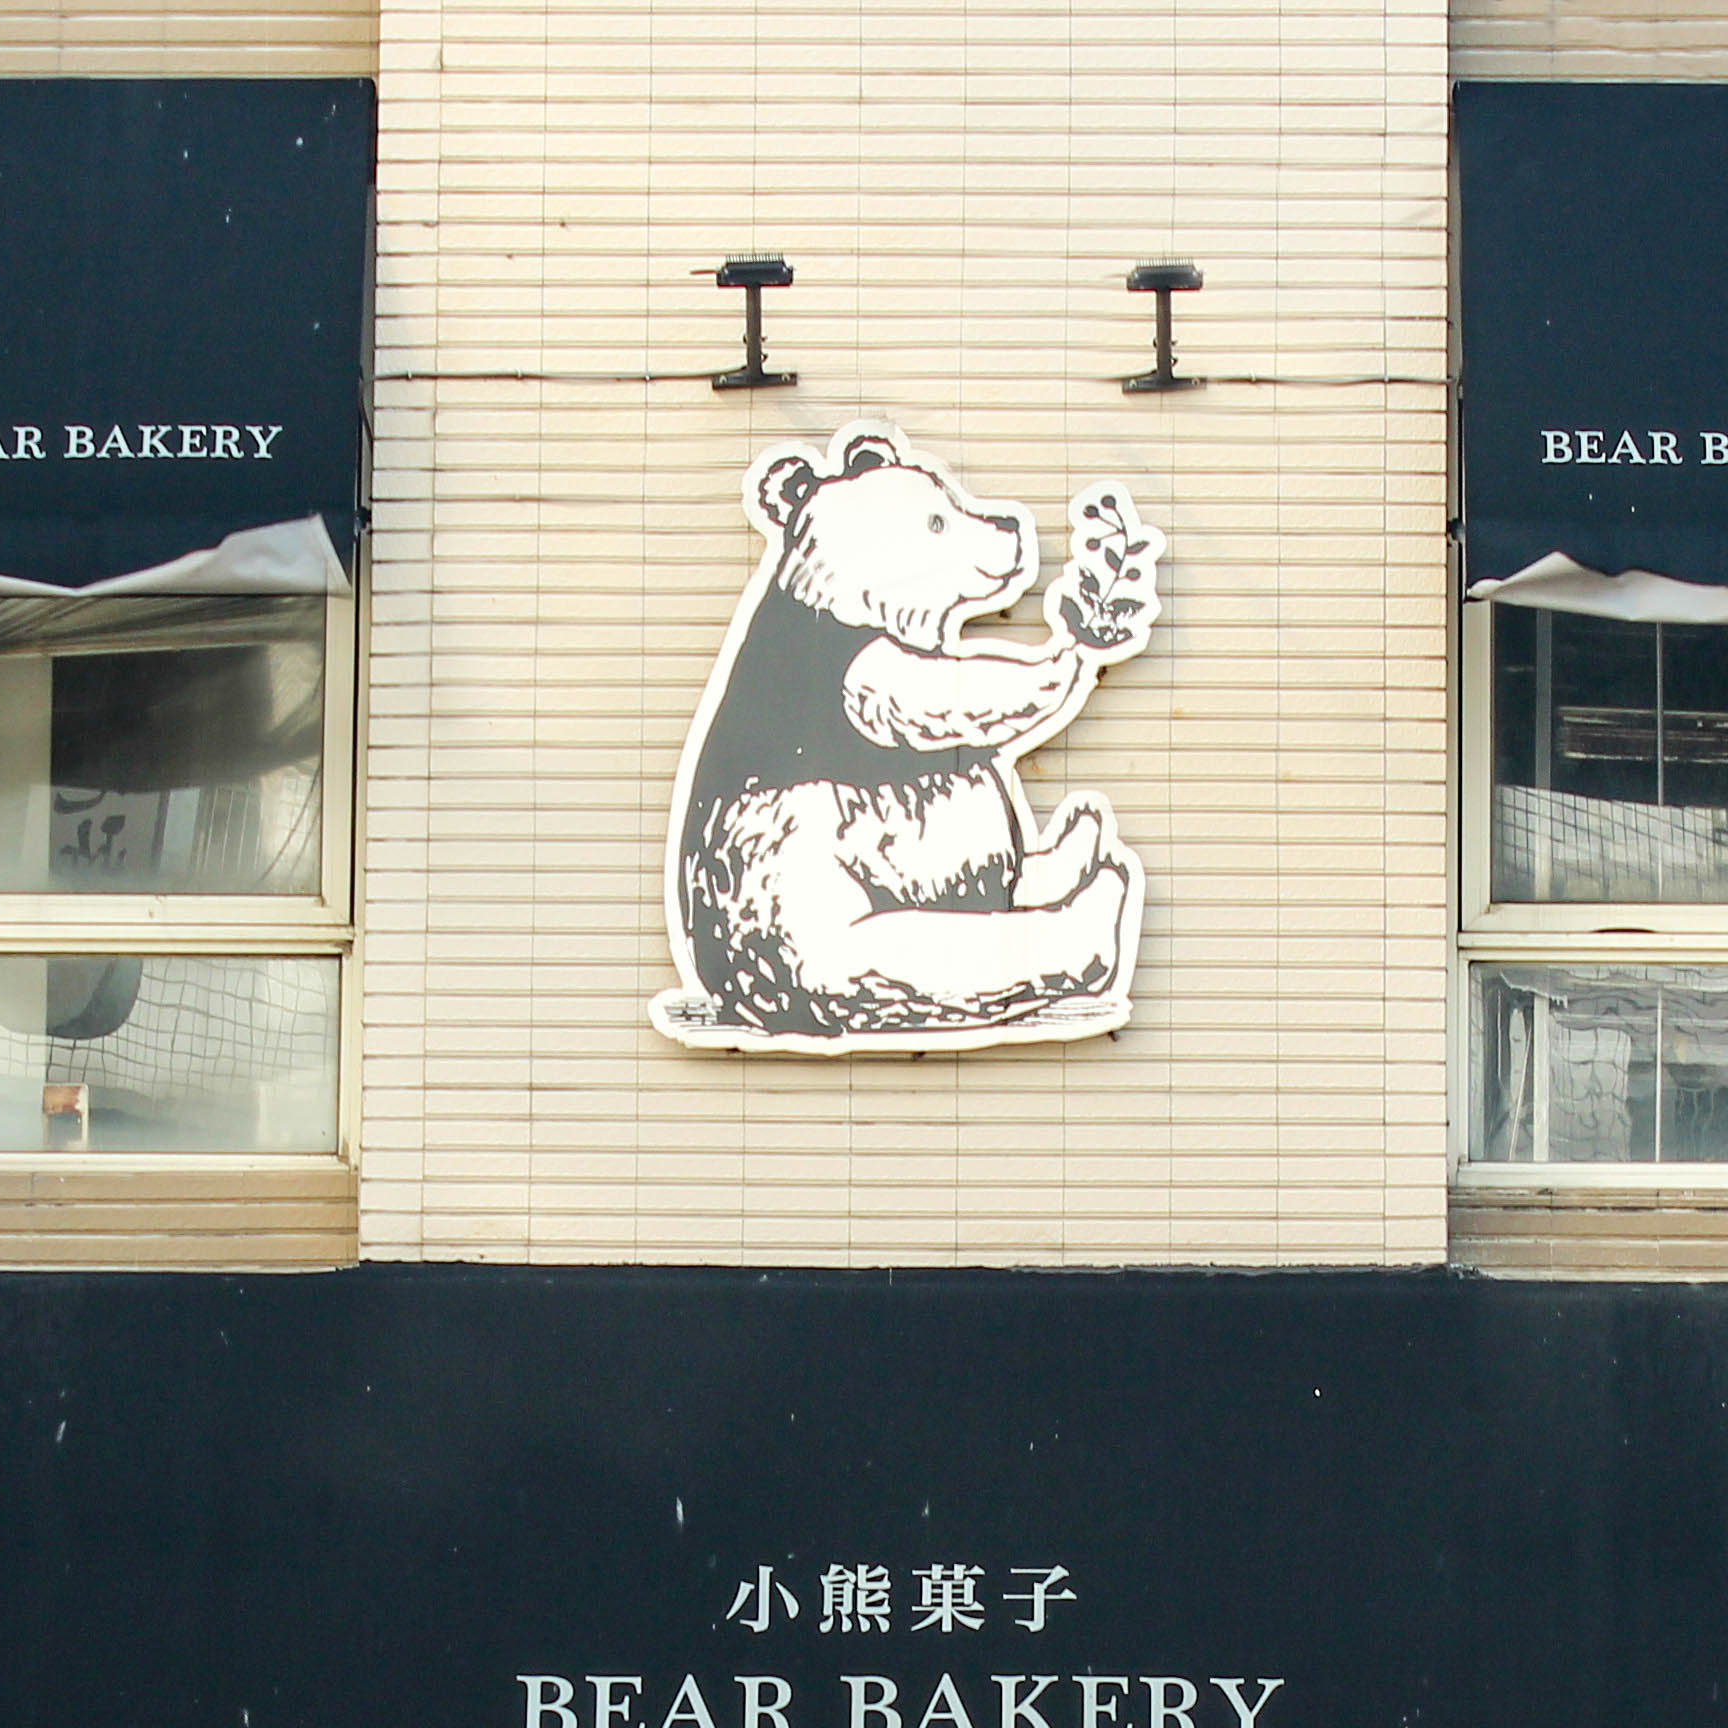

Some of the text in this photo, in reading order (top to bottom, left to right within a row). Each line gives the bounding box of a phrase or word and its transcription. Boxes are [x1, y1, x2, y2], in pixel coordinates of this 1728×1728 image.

[63, 423, 284, 460] BAKERY
[1540, 429, 1684, 465] BEAR
[725, 1563, 1079, 1634] 小熊菓子
